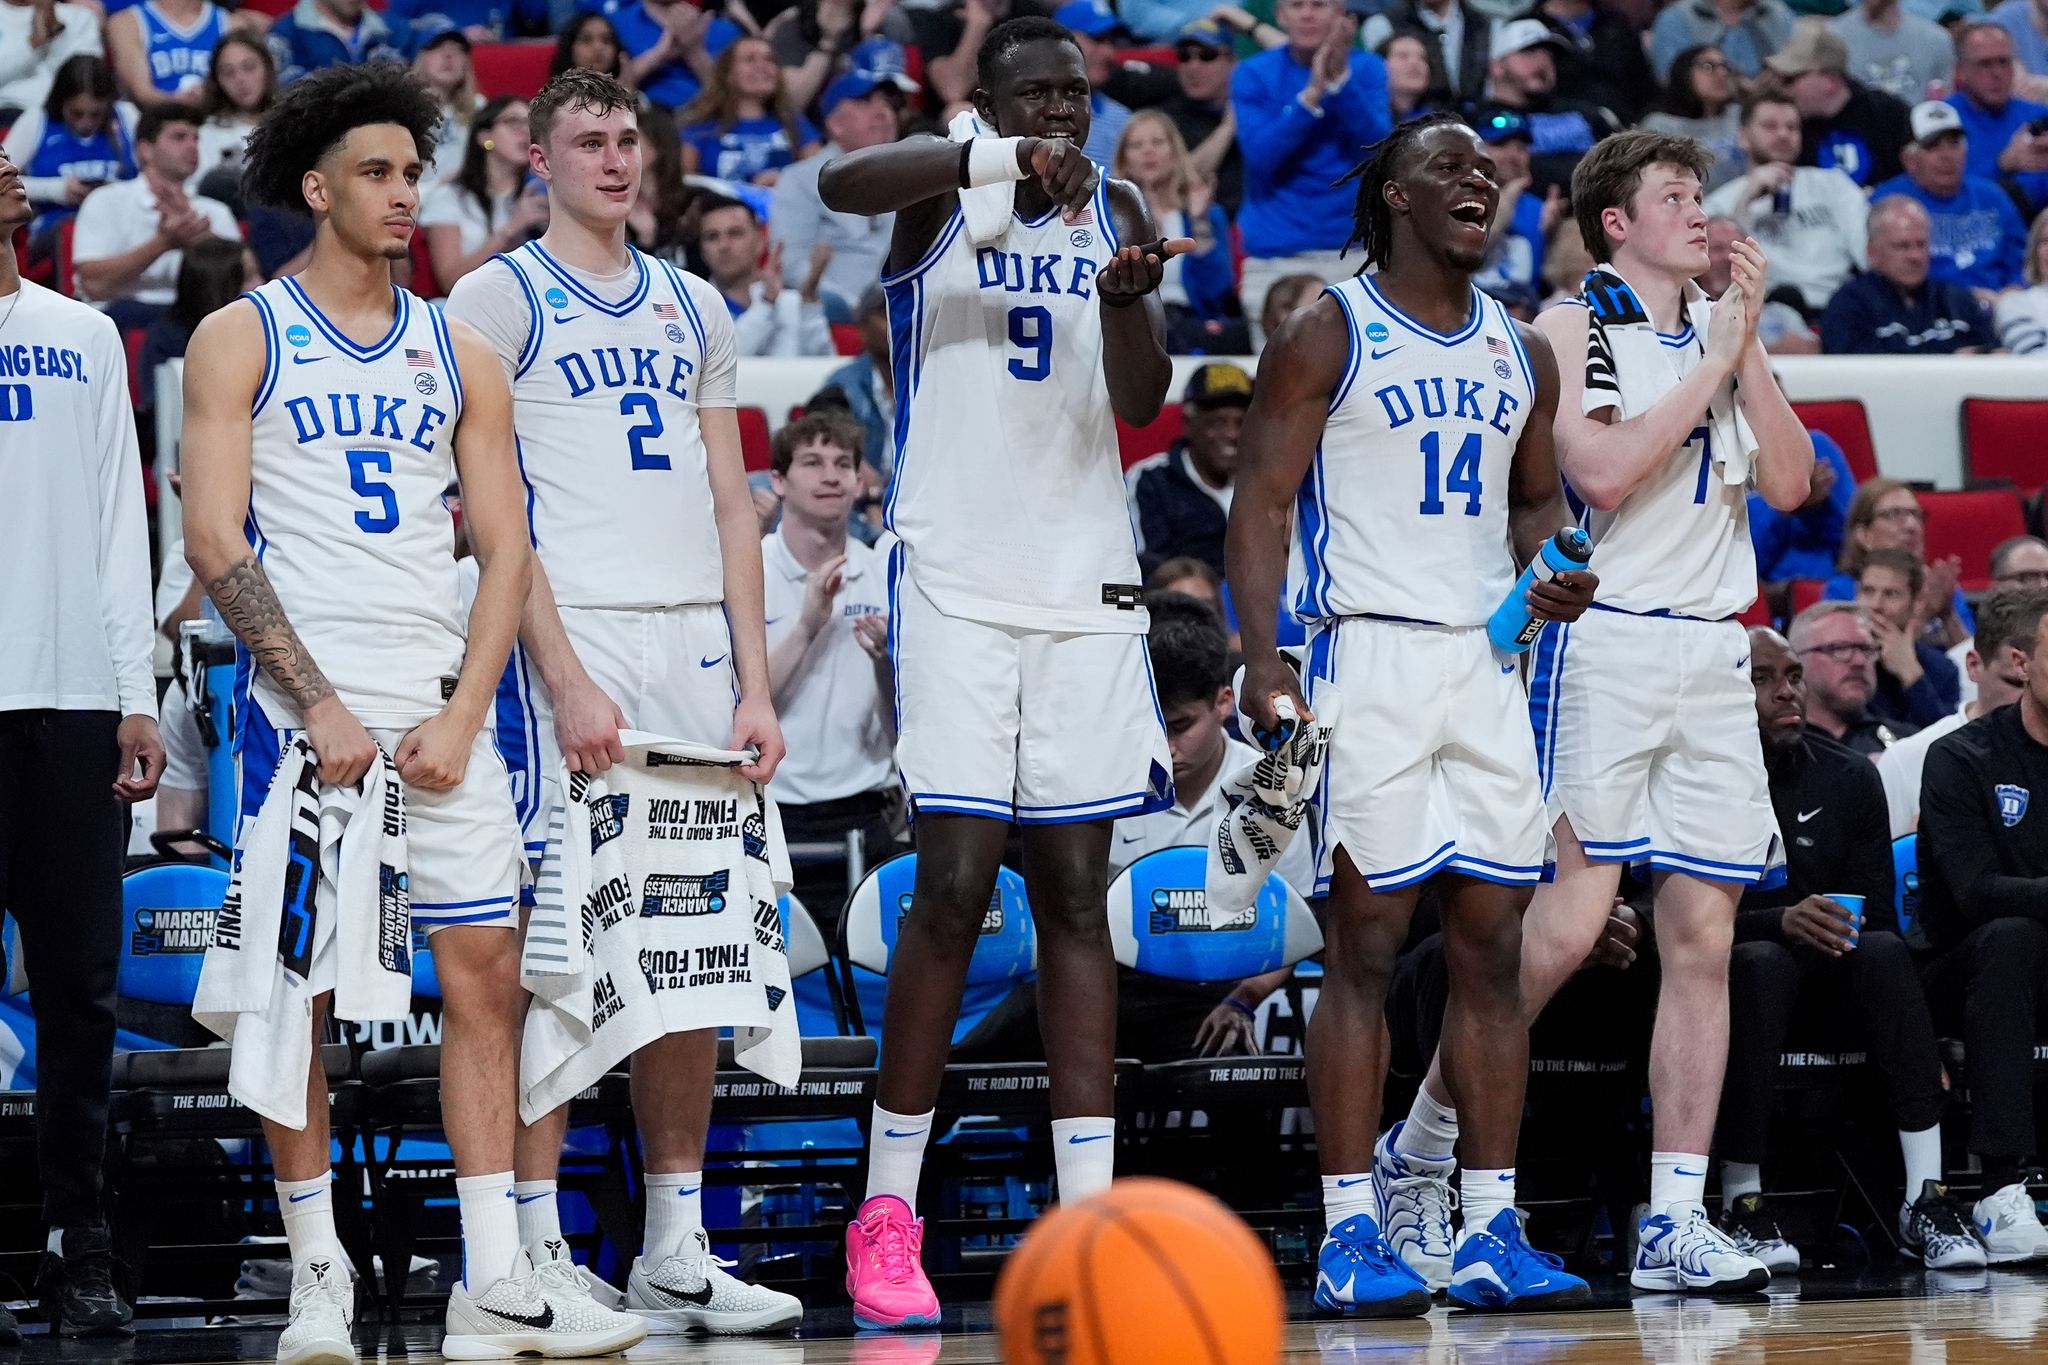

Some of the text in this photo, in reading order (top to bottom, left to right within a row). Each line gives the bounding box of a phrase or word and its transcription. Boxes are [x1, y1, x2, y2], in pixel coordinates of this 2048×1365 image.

[976, 246, 1097, 301] DUKE
[1008, 305, 1053, 382] 9
[32, 345, 88, 384] EASY.
[554, 347, 694, 401] DUKE
[1374, 376, 1519, 436] DUKE
[283, 393, 447, 454] DUKE
[620, 392, 672, 471] 2
[1420, 431, 1483, 516] 14
[1681, 426, 1711, 504] 7
[345, 450, 400, 534] 5
[1520, 617, 1545, 642] ADE
[694, 798, 738, 825] FINAL
[648, 824, 740, 841] THE ROAD TO THE
[644, 881, 701, 897] MADNESS
[1169, 891, 1207, 909] MAR
[394, 889, 409, 947] MARCH
[660, 897, 709, 915] MARCH
[154, 910, 215, 929] MARCH
[600, 906, 623, 932] THE
[163, 929, 213, 948] MADN
[383, 895, 396, 970] MADNESS
[695, 943, 750, 971] FINAL
[669, 975, 686, 990] TO
[689, 970, 724, 986] ROAD
[728, 969, 752, 983] THE
[1786, 1052, 1806, 1066] THE
[1807, 1052, 1837, 1066] FINAL
[967, 1076, 1050, 1091] THE ROAD TO TH
[1209, 1068, 1230, 1082] THE
[1231, 1067, 1262, 1081] ROAD
[1262, 1067, 1278, 1080] TO
[1279, 1067, 1299, 1080] THE
[172, 1095, 196, 1109] THE
[196, 1094, 228, 1108] ROAD
[713, 1084, 728, 1097] HE
[730, 1083, 760, 1097] ROAD
[762, 1083, 777, 1096] TO
[800, 1082, 832, 1095] FINAL
[833, 1081, 863, 1094] FOUR
[1, 1102, 35, 1116] FINAL
